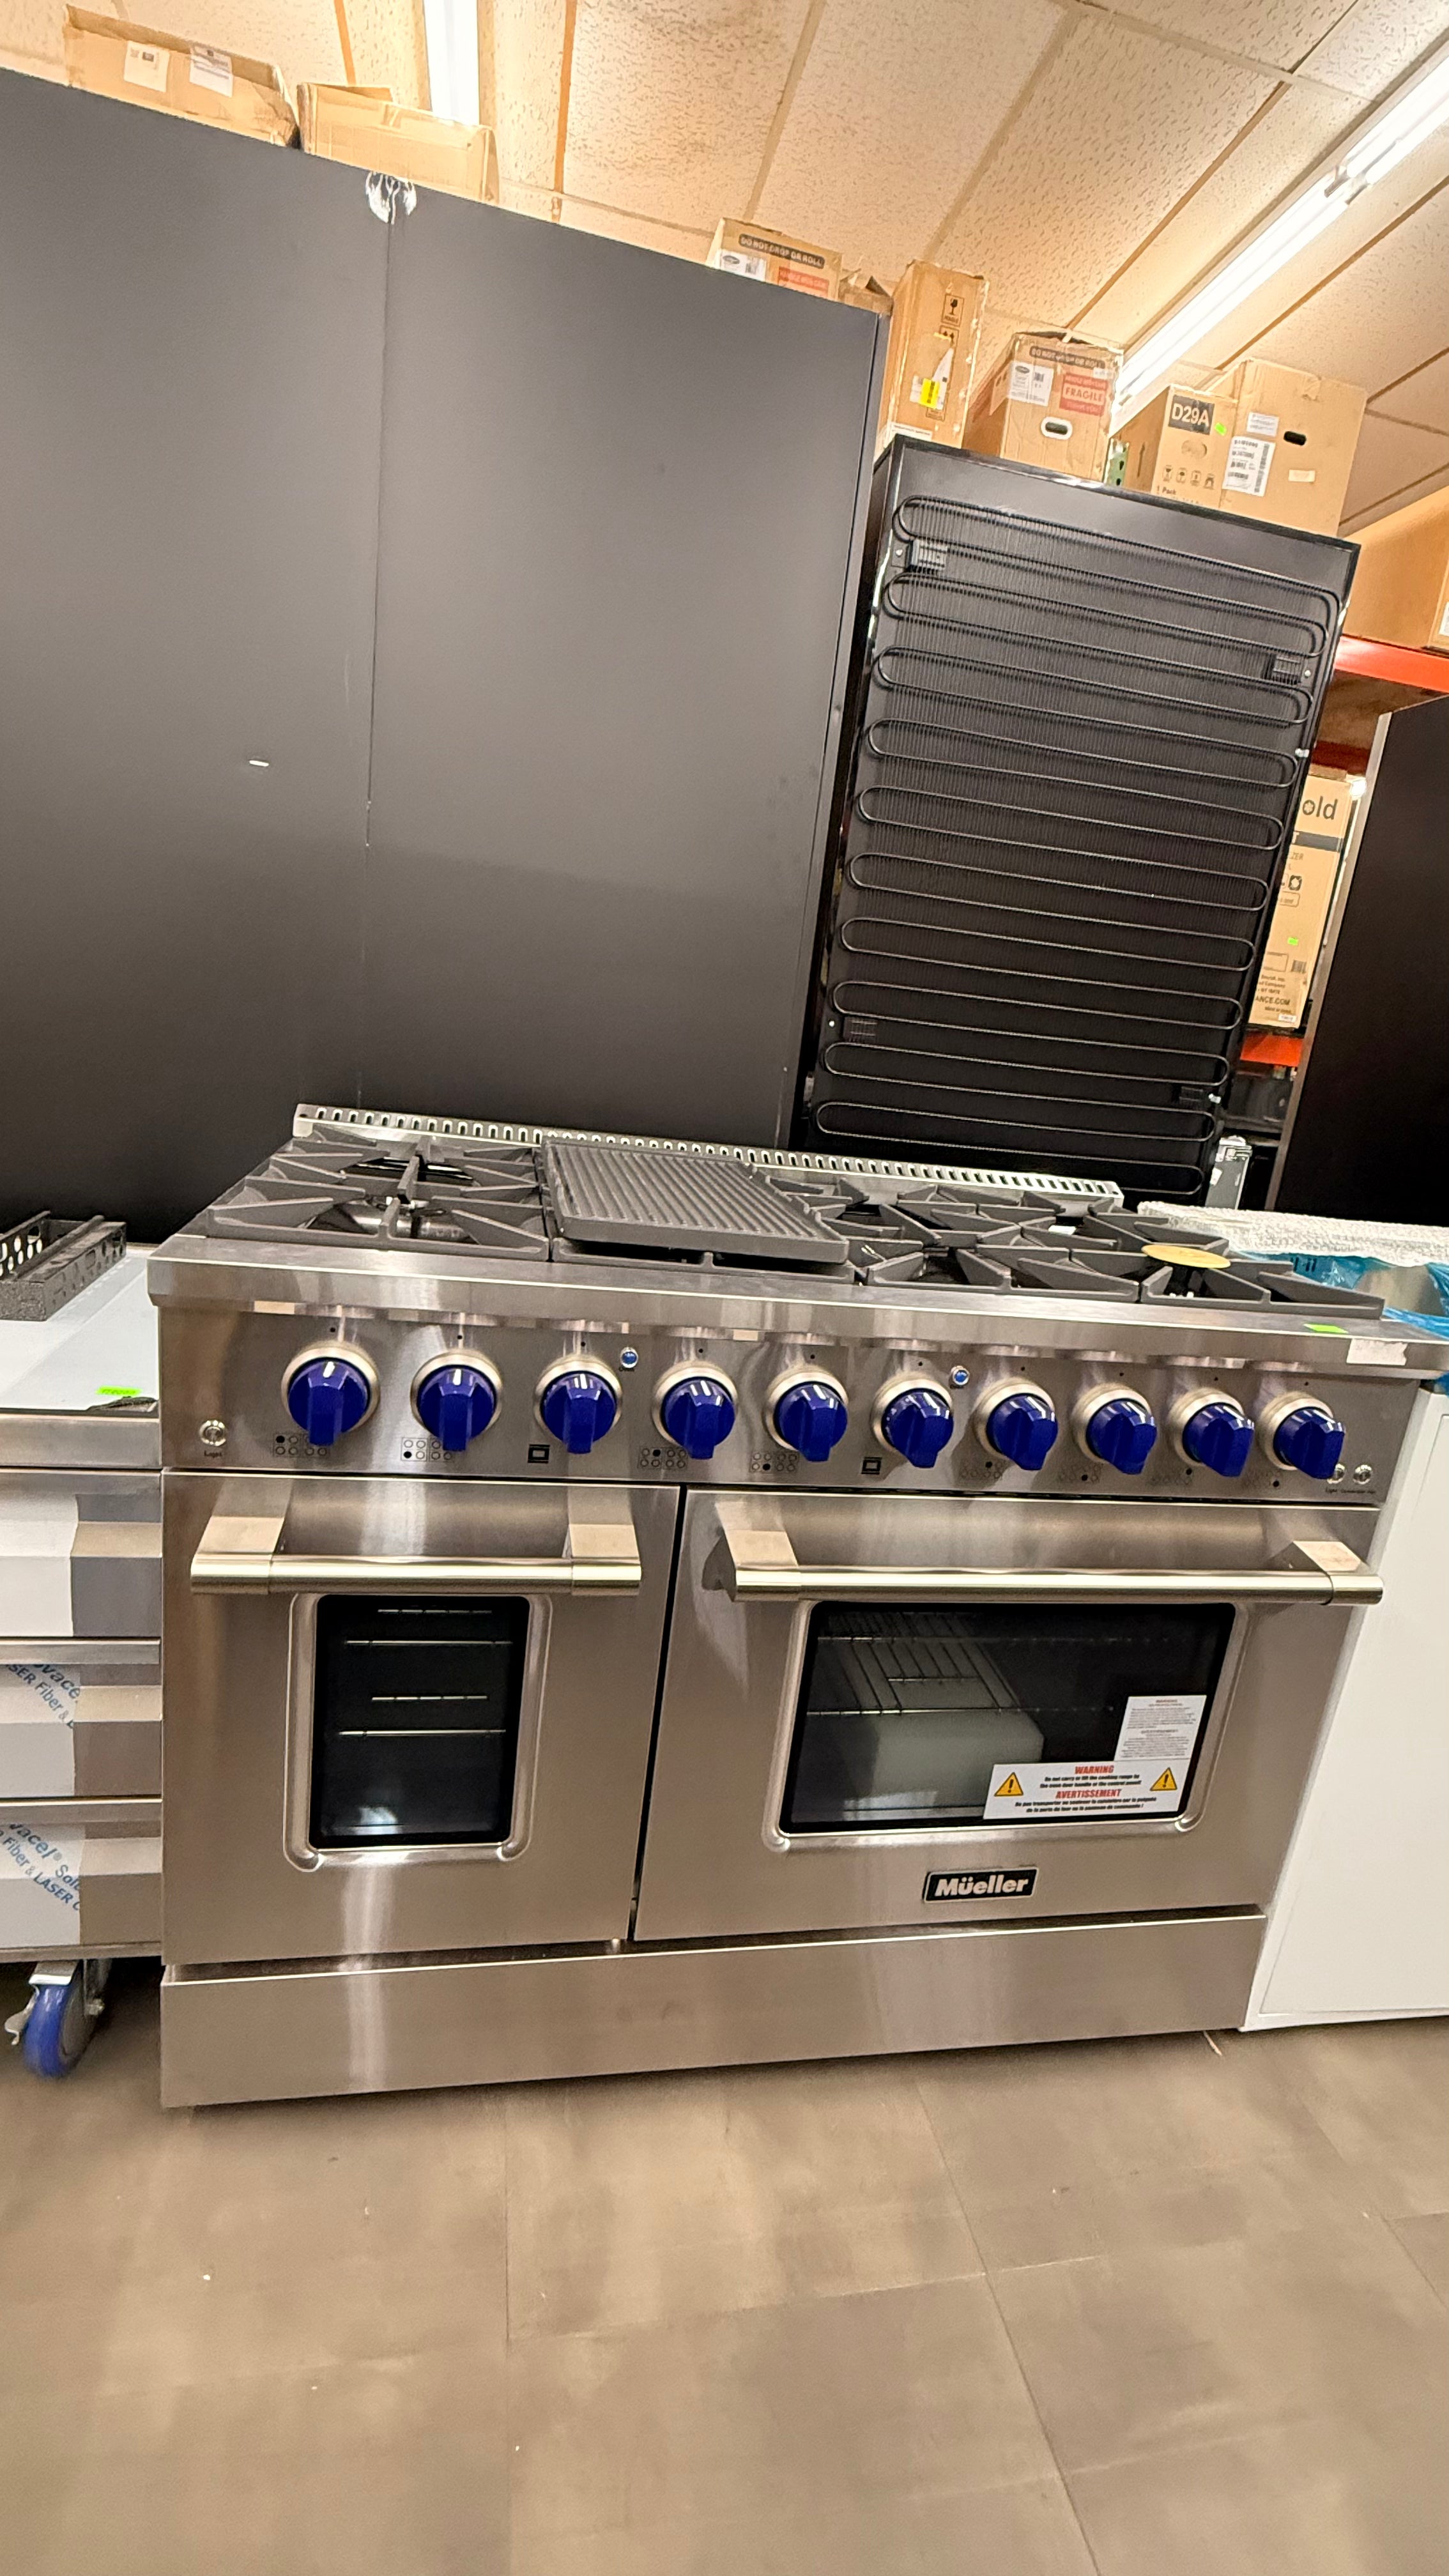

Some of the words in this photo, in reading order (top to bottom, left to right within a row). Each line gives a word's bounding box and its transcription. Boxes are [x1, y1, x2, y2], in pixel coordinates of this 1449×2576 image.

[1066, 387, 1103, 402] FRAGILE
[1171, 402, 1210, 427] D29A
[1162, 486, 1177, 495] Pack
[1302, 795, 1338, 820] old
[1255, 995, 1291, 1006] ANCE.COM
[34, 1682, 64, 1711] Fiber
[1075, 1765, 1114, 1774] WARNING
[1055, 1789, 1123, 1800] AVERTISSEMENT
[3, 1837, 31, 1867] Fiber
[33, 1871, 73, 1904] LASER
[934, 1874, 1029, 1897] Müeller
